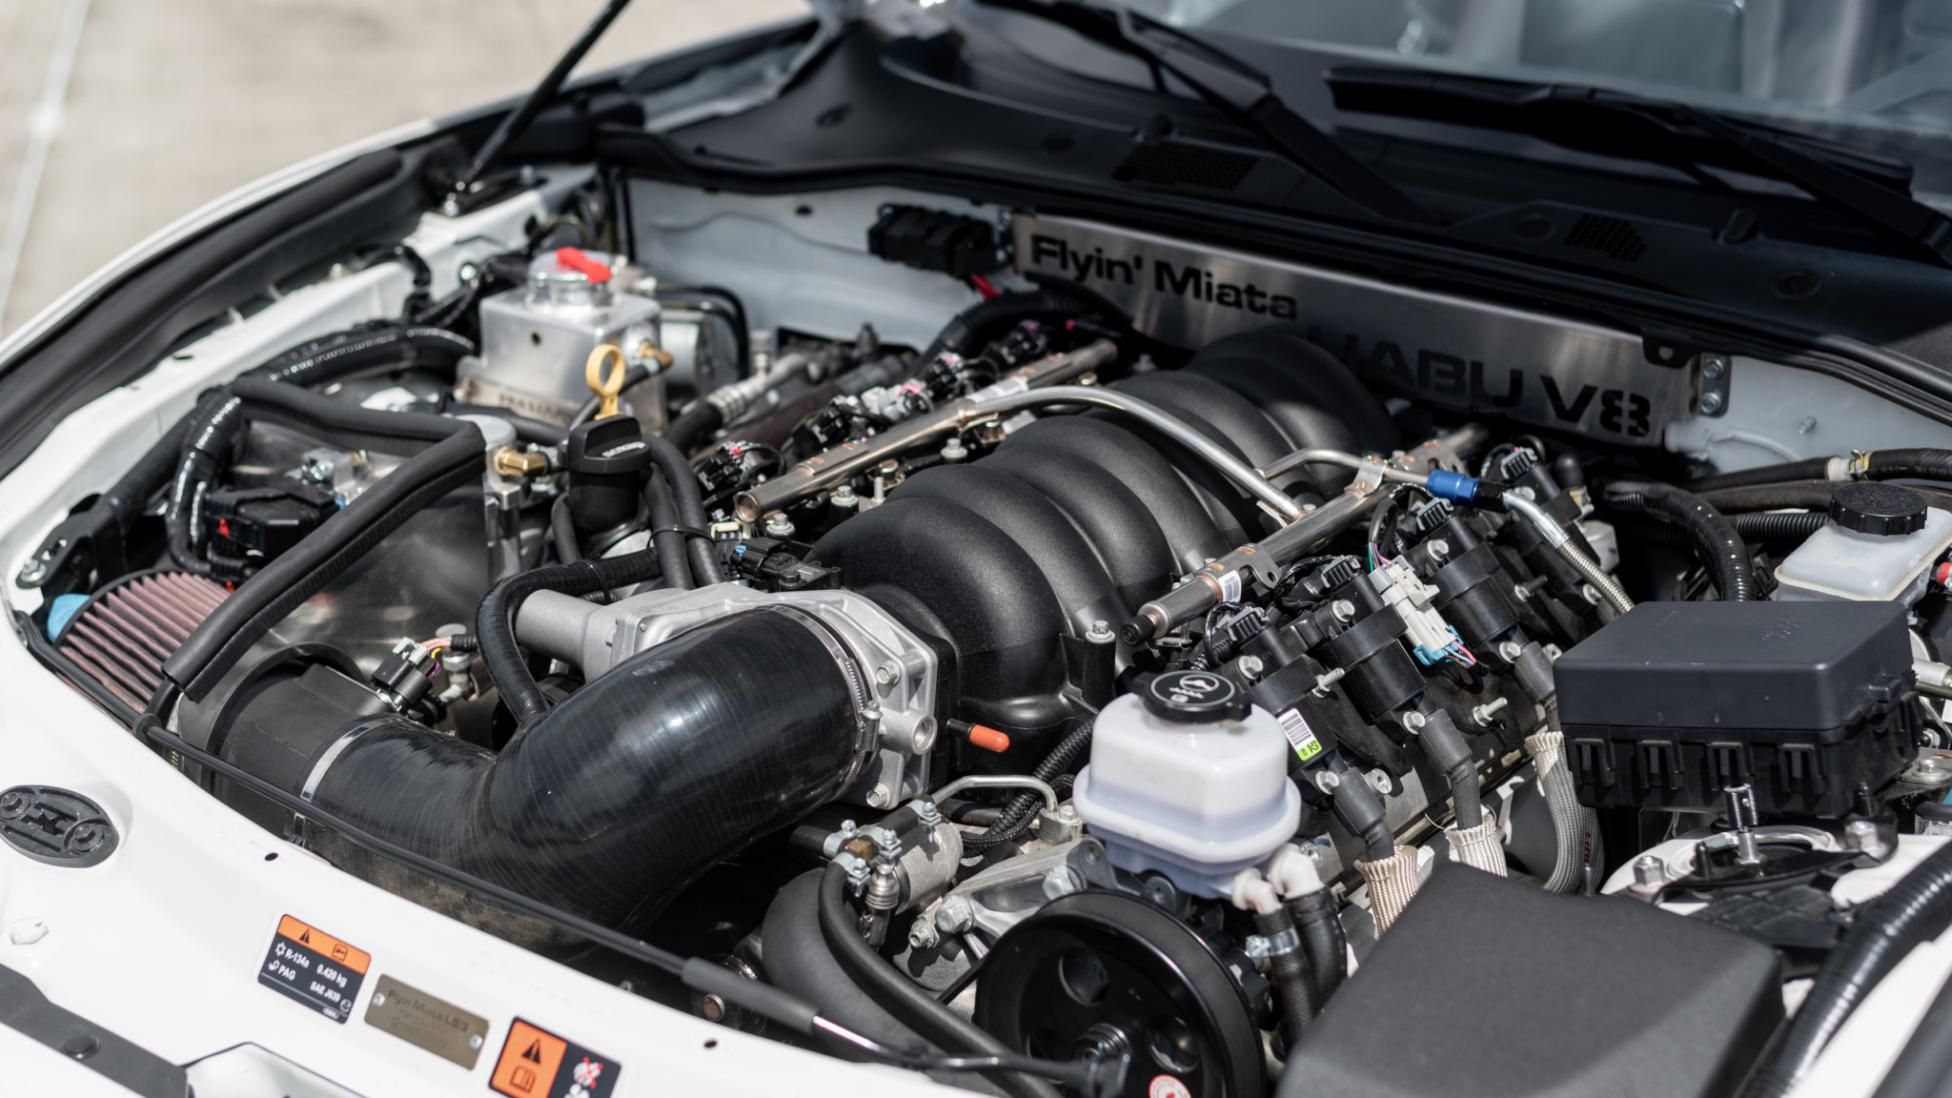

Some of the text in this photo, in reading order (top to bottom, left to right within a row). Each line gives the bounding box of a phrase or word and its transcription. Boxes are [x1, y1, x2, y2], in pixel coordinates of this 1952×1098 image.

[1031, 234, 1297, 320] Flyin' Miata
[1540, 373, 1650, 437] V8
[278, 964, 297, 981] PAG
[336, 973, 348, 988] kg
